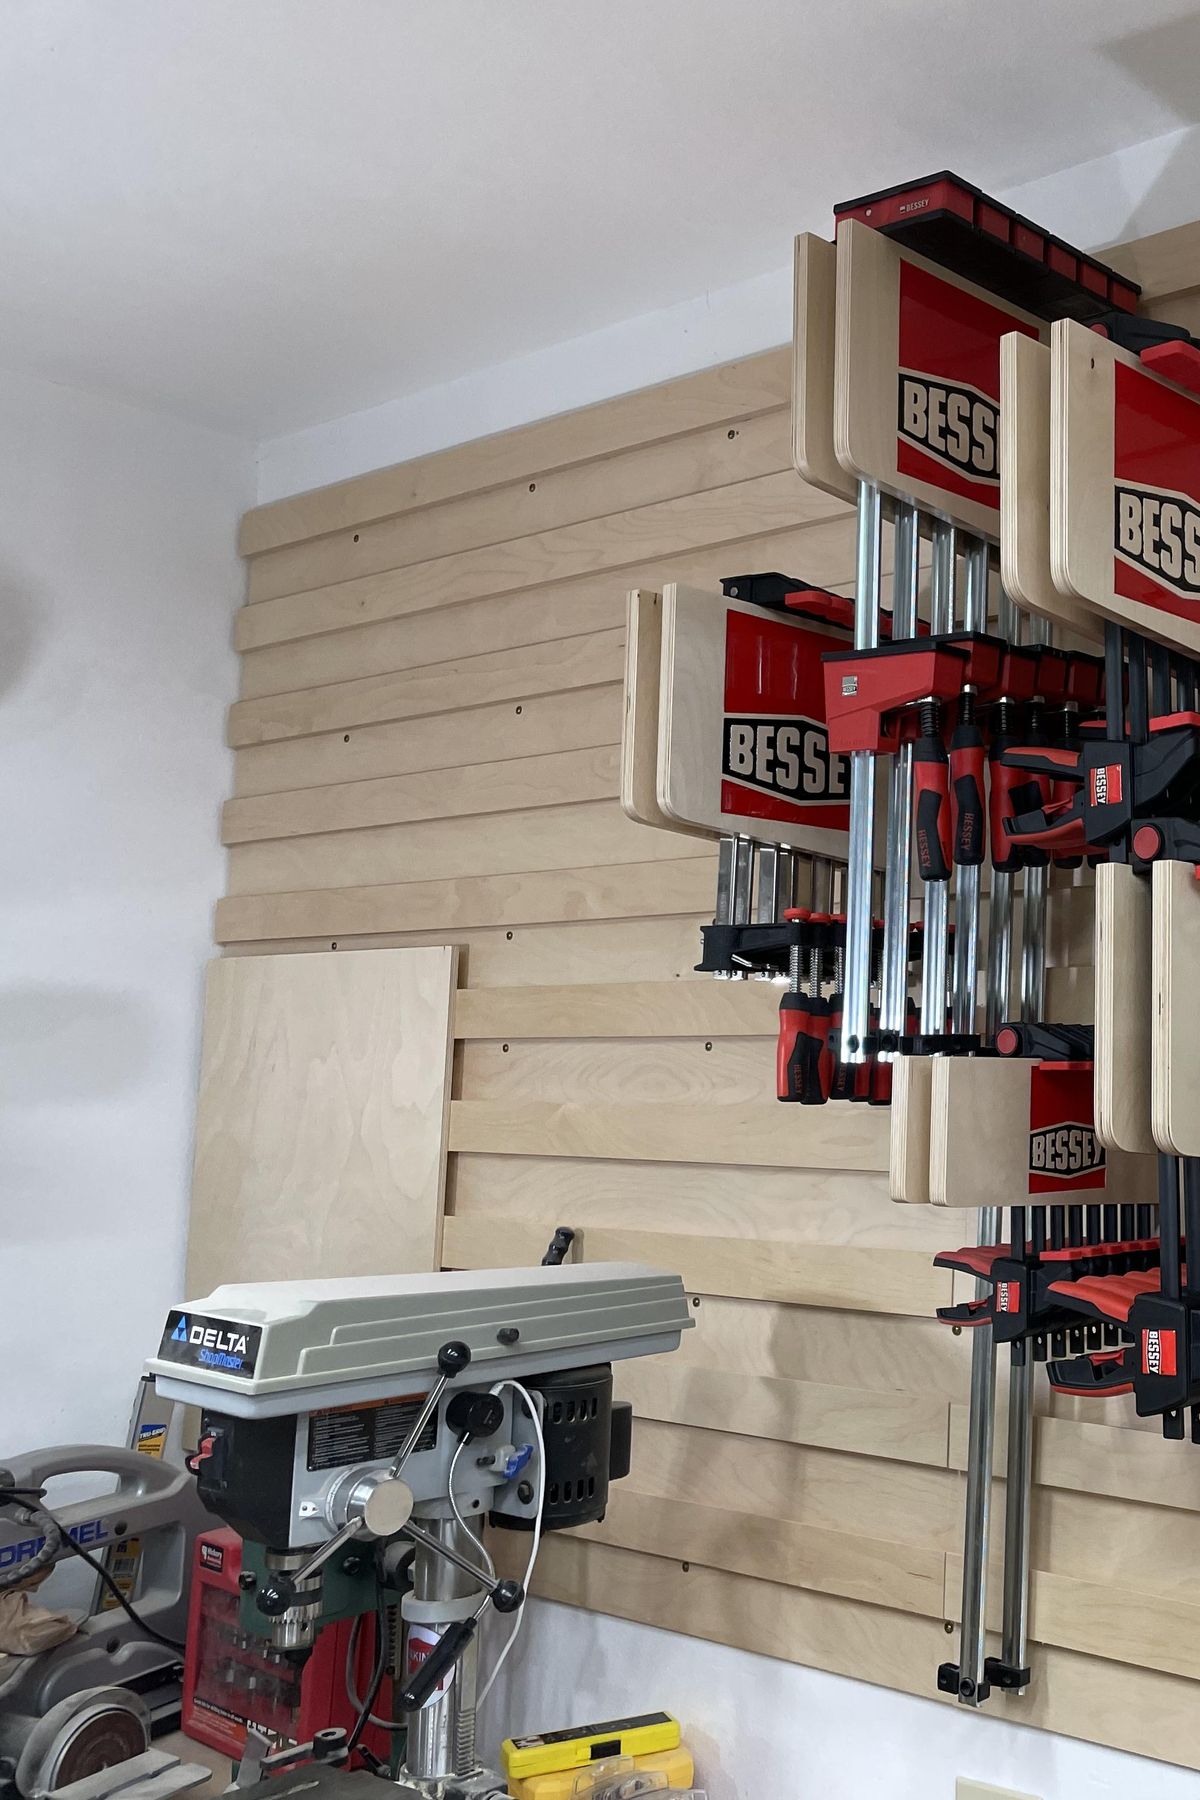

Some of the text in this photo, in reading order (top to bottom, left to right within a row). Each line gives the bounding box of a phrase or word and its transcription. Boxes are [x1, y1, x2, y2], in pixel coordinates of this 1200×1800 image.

[904, 380, 1000, 474] BESS
[729, 724, 845, 794] BESSE
[1096, 767, 1107, 804] BESSEY
[1032, 1130, 1102, 1170] BESSEY
[1000, 1282, 1008, 1312] BESSEY
[189, 1325, 247, 1354] DELTA
[1147, 1331, 1160, 1374] BESSEY
